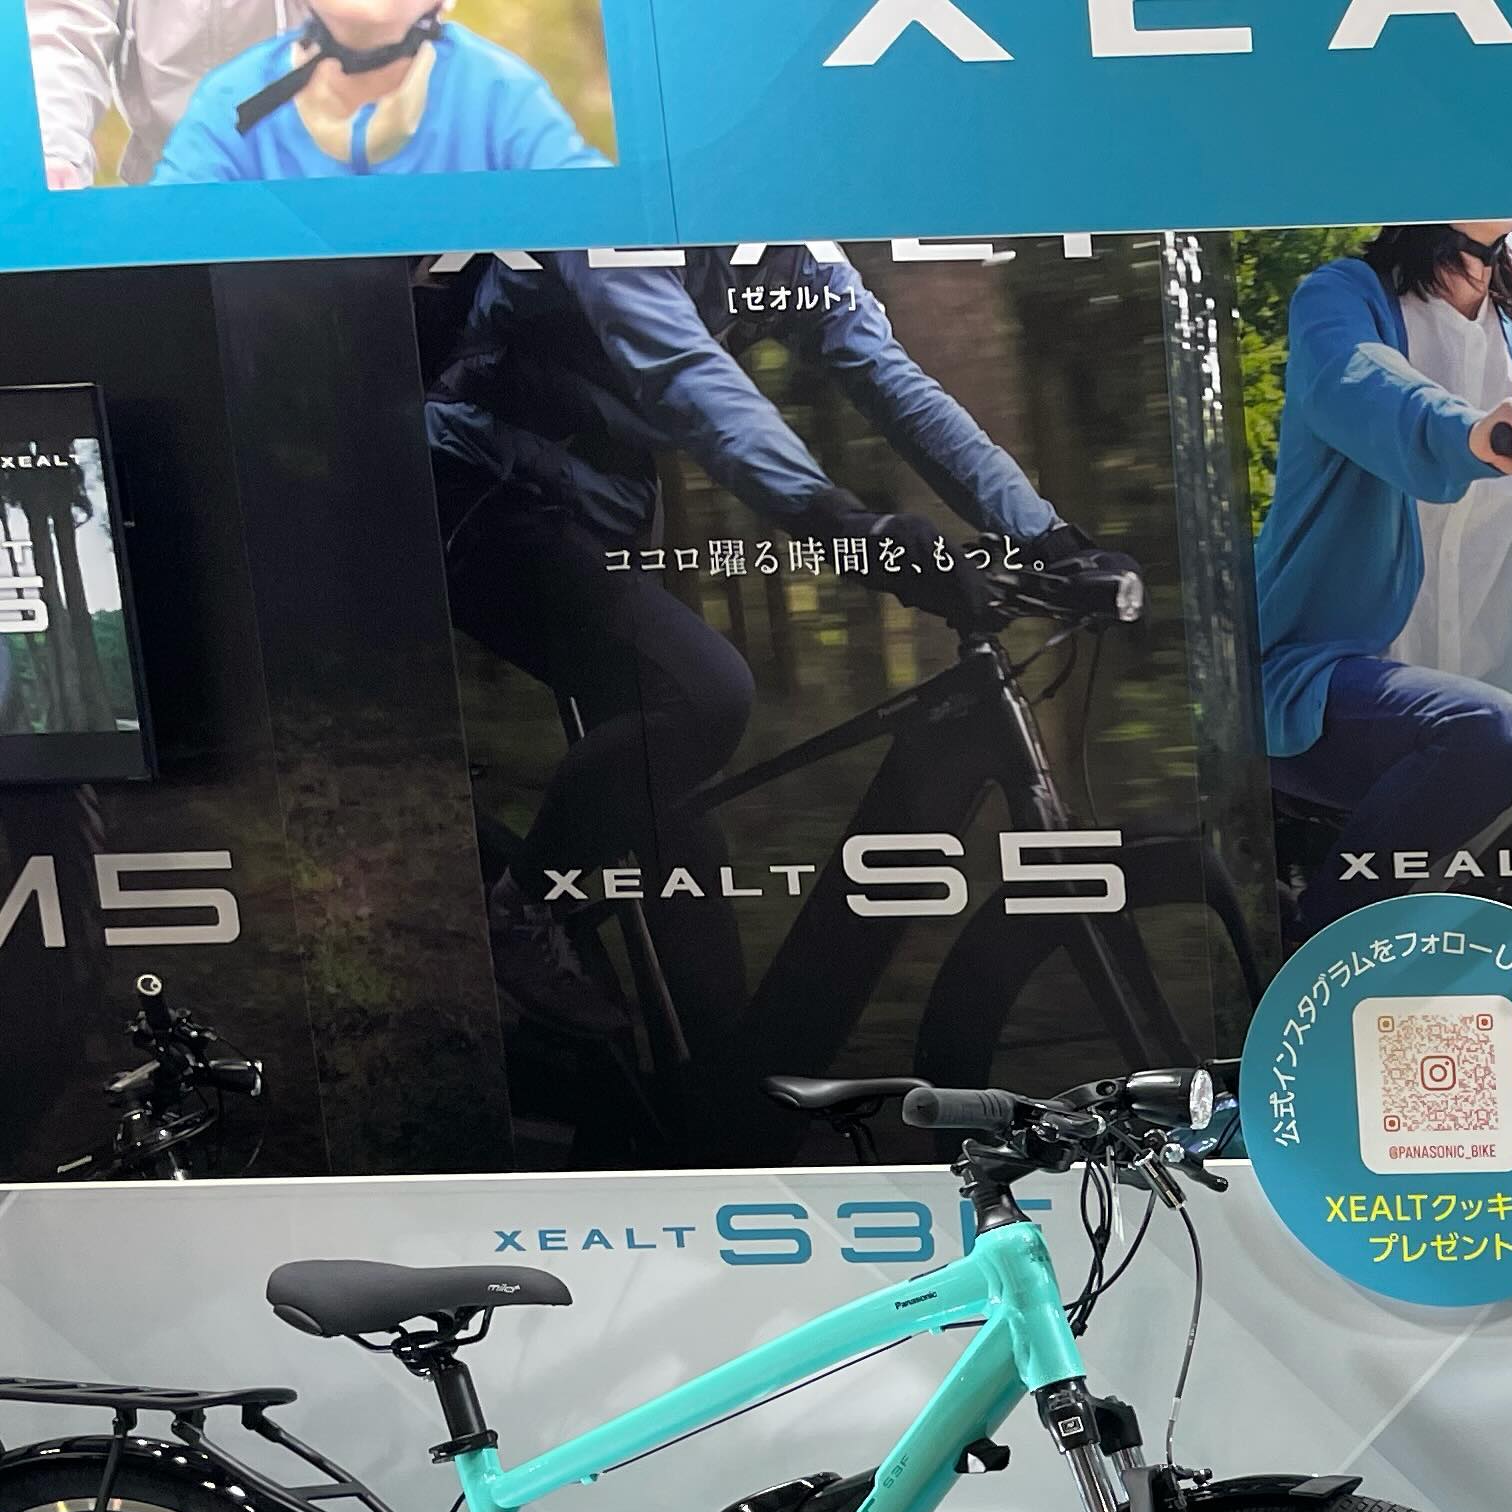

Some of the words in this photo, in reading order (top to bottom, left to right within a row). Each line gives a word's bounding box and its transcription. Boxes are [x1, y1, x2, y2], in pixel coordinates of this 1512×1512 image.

[605, 535, 1046, 577] ココロ躍る時間を、もっと。
[544, 865, 816, 900] XEALT
[843, 831, 1128, 917] S5
[1389, 1144, 1497, 1160] @PANASONIC_BIKE
[494, 1226, 696, 1252] XEALT
[894, 1291, 938, 1310] Panasonic
[882, 1453, 911, 1490] S3F
